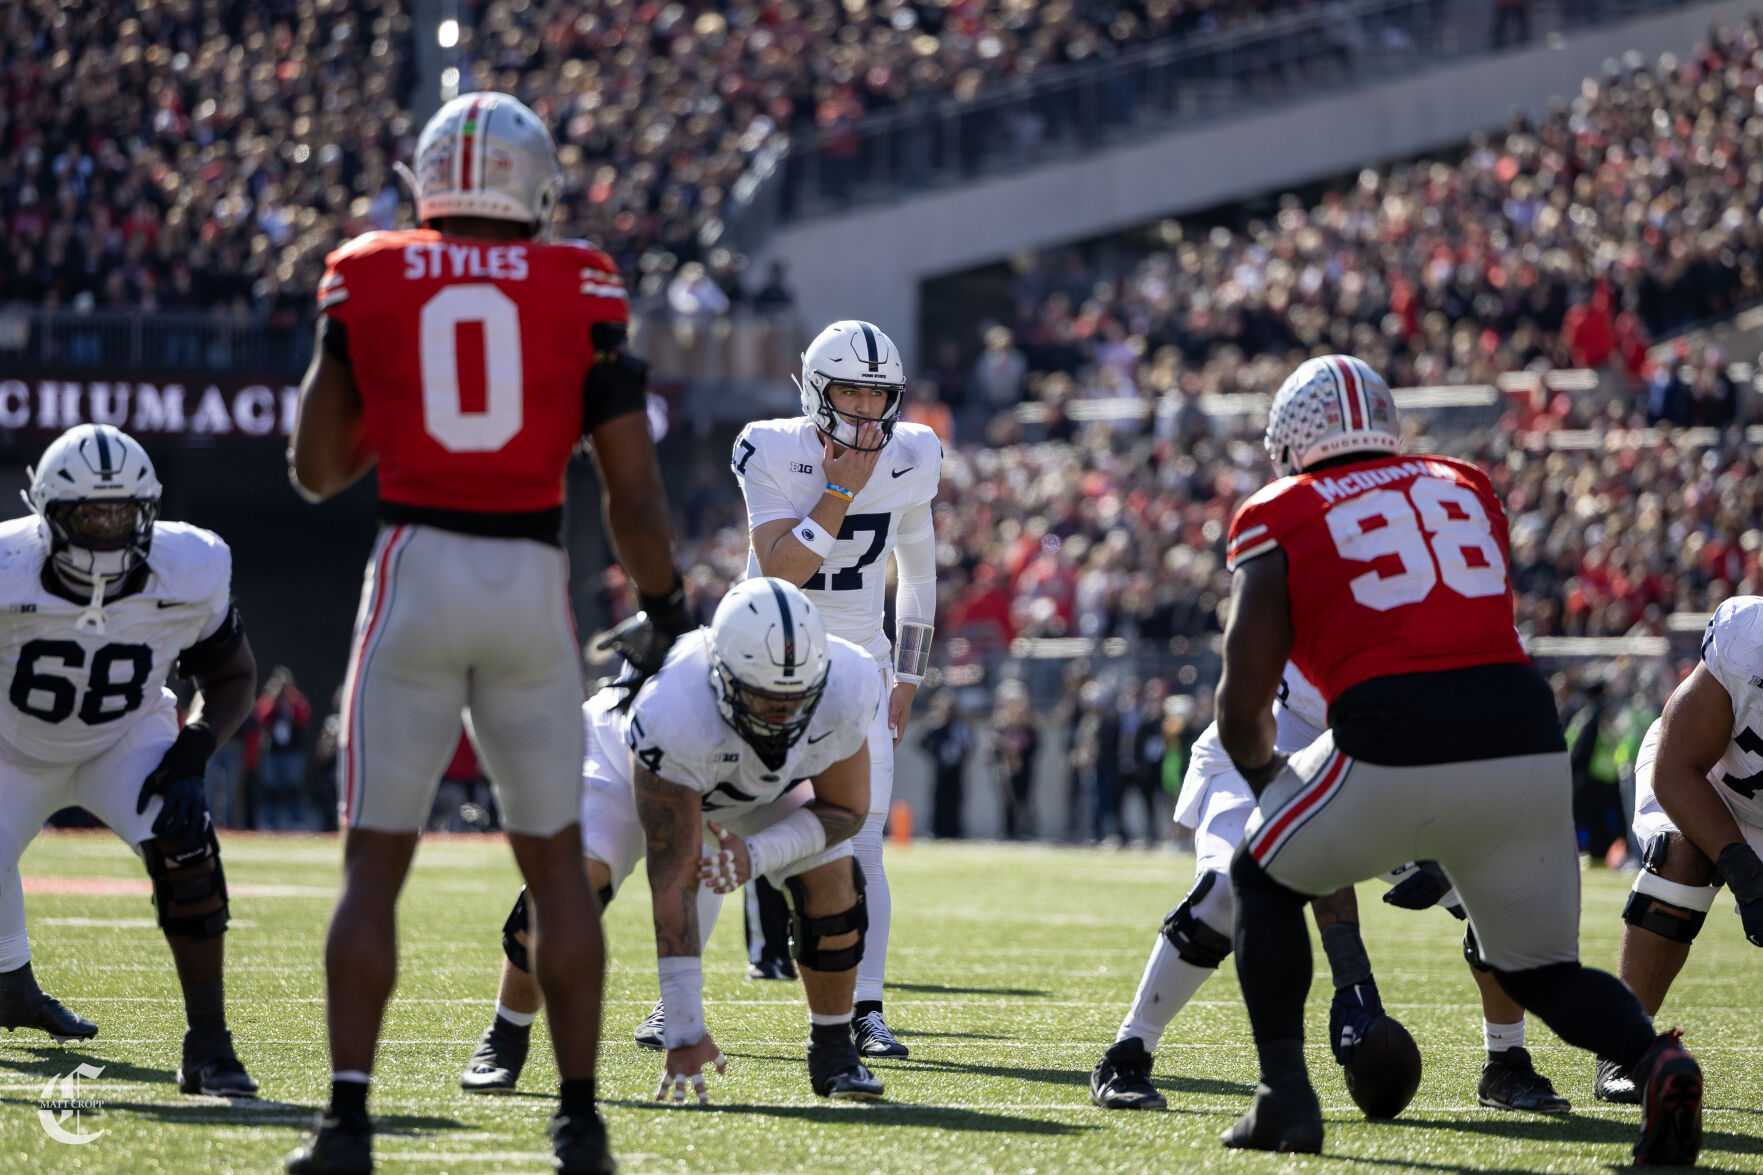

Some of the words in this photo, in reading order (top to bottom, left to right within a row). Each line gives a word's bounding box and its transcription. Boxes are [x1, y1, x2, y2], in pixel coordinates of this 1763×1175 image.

[404, 242, 529, 281] STYLES
[419, 282, 524, 454] 0
[1325, 476, 1507, 612] 98
[9, 638, 154, 727] 68
